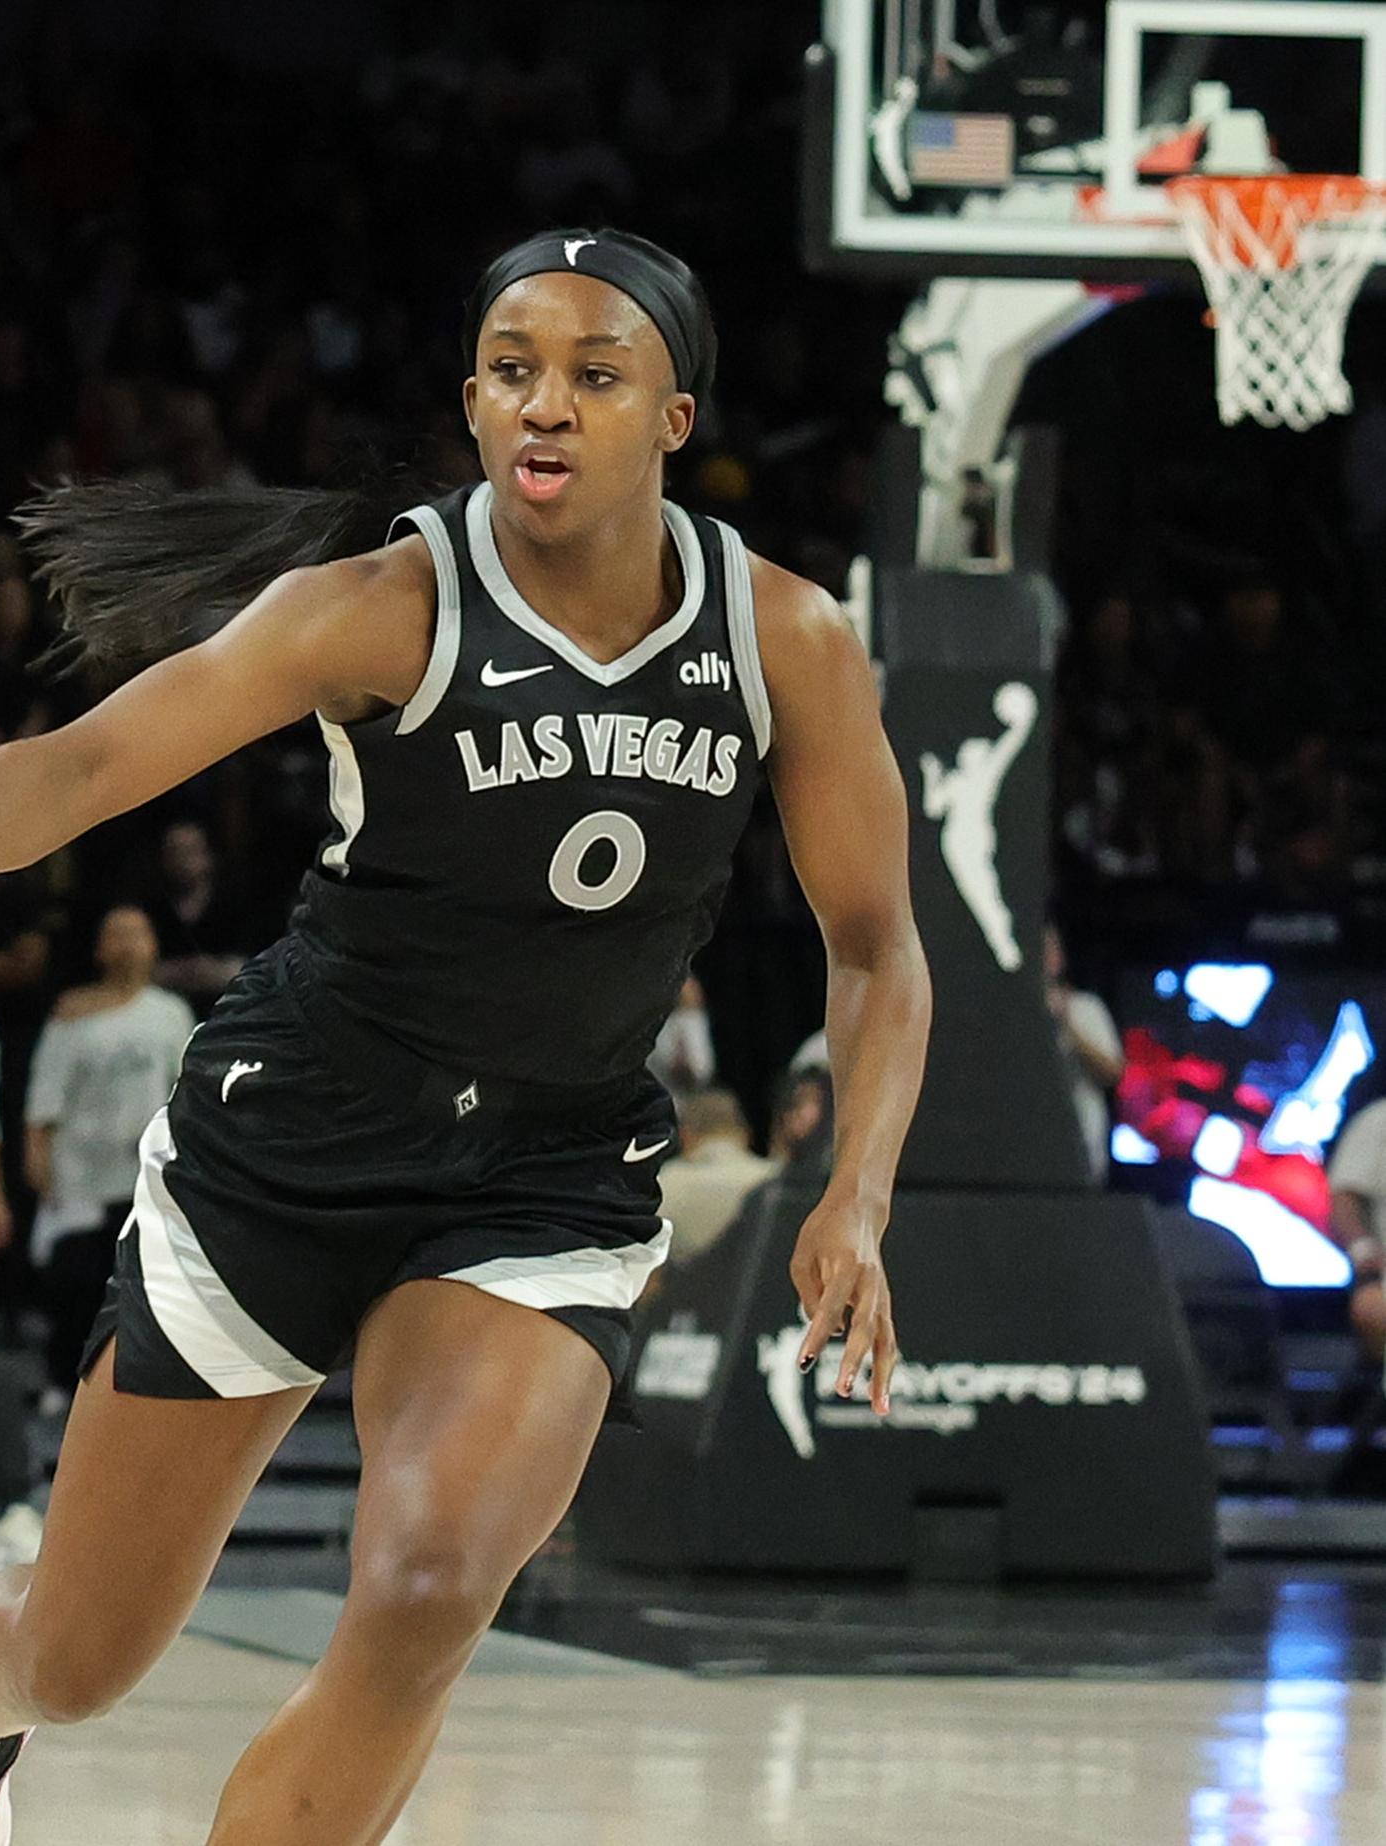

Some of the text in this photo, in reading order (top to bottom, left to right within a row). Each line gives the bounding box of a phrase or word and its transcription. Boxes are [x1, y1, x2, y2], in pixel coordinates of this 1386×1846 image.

[678, 651, 731, 692] ally
[454, 713, 743, 797] LAS VEGAS
[548, 809, 647, 912] 0
